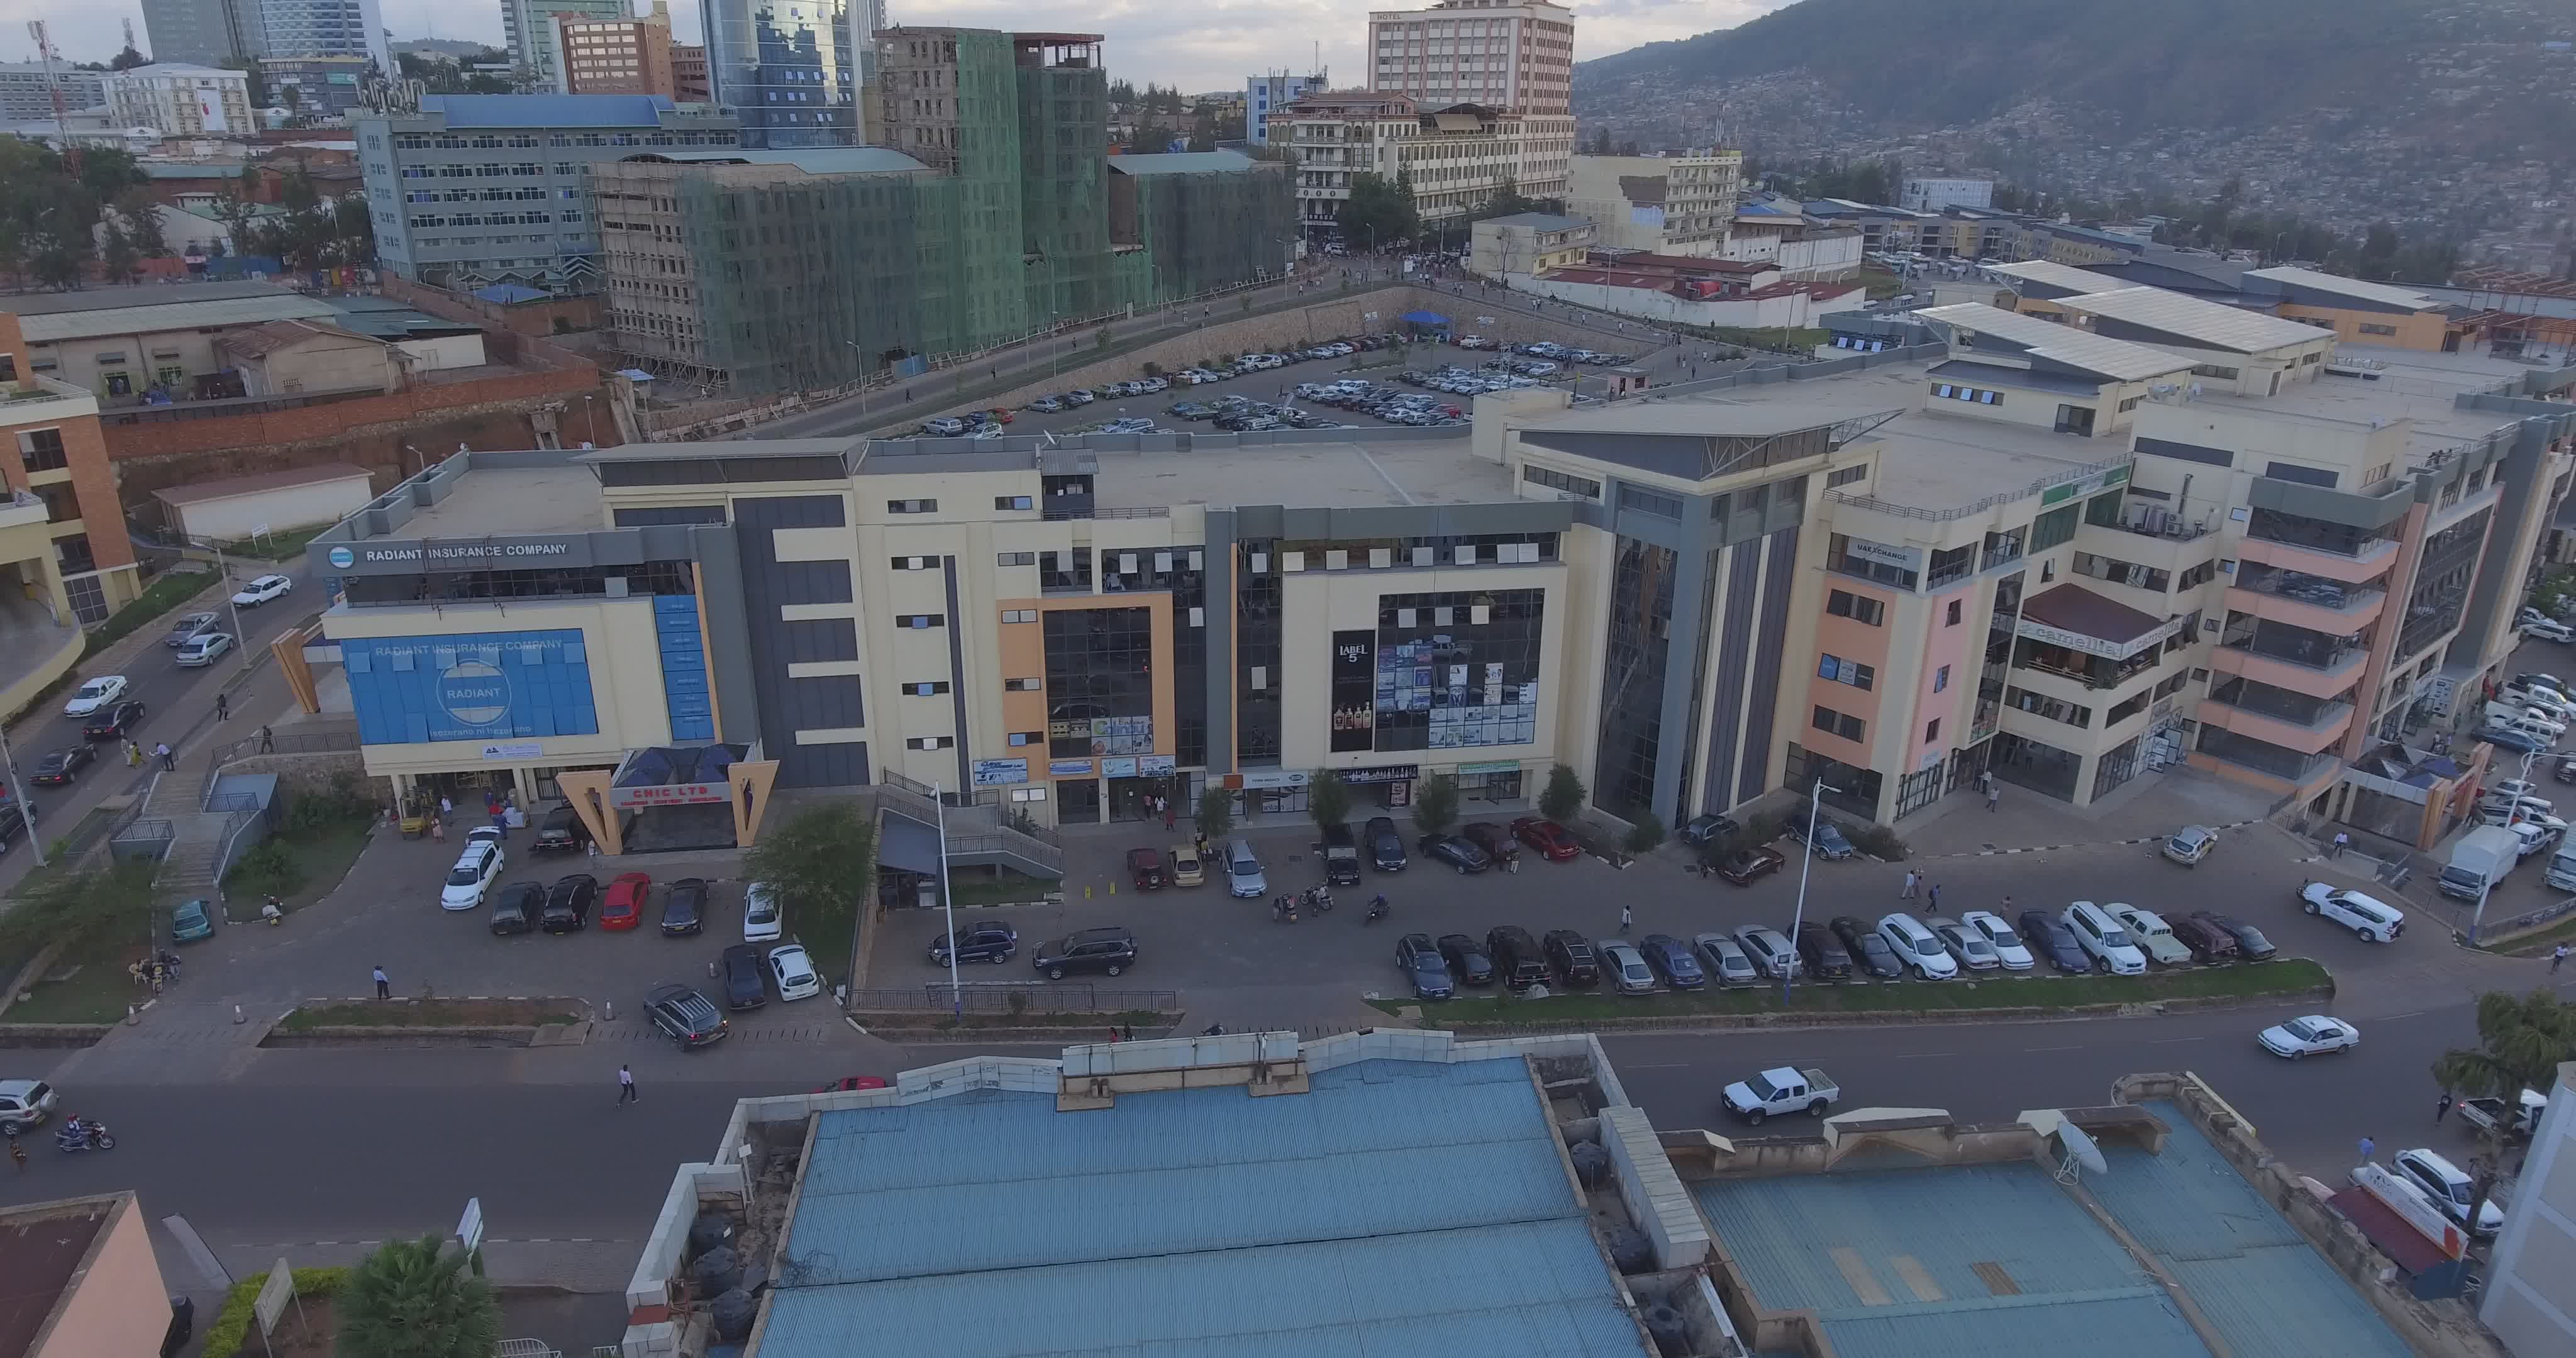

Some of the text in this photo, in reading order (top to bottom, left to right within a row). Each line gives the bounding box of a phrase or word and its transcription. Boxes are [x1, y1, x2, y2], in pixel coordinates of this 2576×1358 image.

[366, 549, 423, 562] RADIANT
[428, 546, 502, 559] INSURANCE
[506, 544, 567, 556] COMPANY
[376, 639, 564, 656] RADIANT INSURANCE COMPANY
[2037, 627, 2118, 656] camellia
[1340, 644, 1368, 656] LABEL
[1348, 653, 1357, 663] 5
[447, 688, 502, 699] RADIANT
[679, 787, 708, 795] LTD
